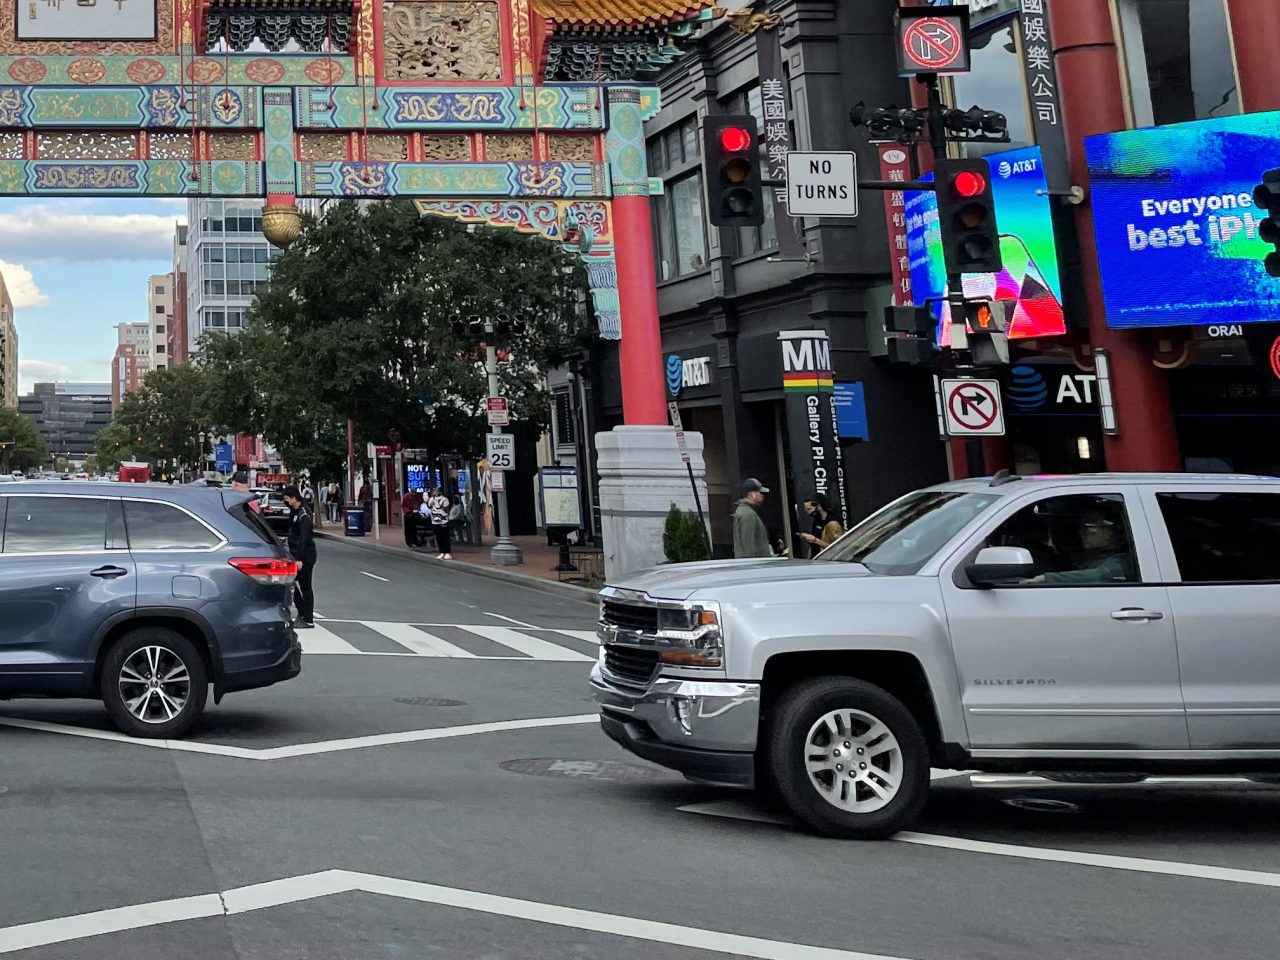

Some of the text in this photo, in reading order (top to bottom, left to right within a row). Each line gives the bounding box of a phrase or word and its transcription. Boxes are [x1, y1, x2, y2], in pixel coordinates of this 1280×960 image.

[809, 160, 832, 174] NO
[1012, 159, 1037, 174] AT&T
[796, 185, 848, 199] TURNS
[1141, 192, 1252, 217] Everyone
[1127, 212, 1264, 251] best iPh
[682, 356, 710, 388] AT&T
[1056, 374, 1096, 404] AT
[806, 396, 820, 443] Gallery
[492, 453, 510, 466] 25
